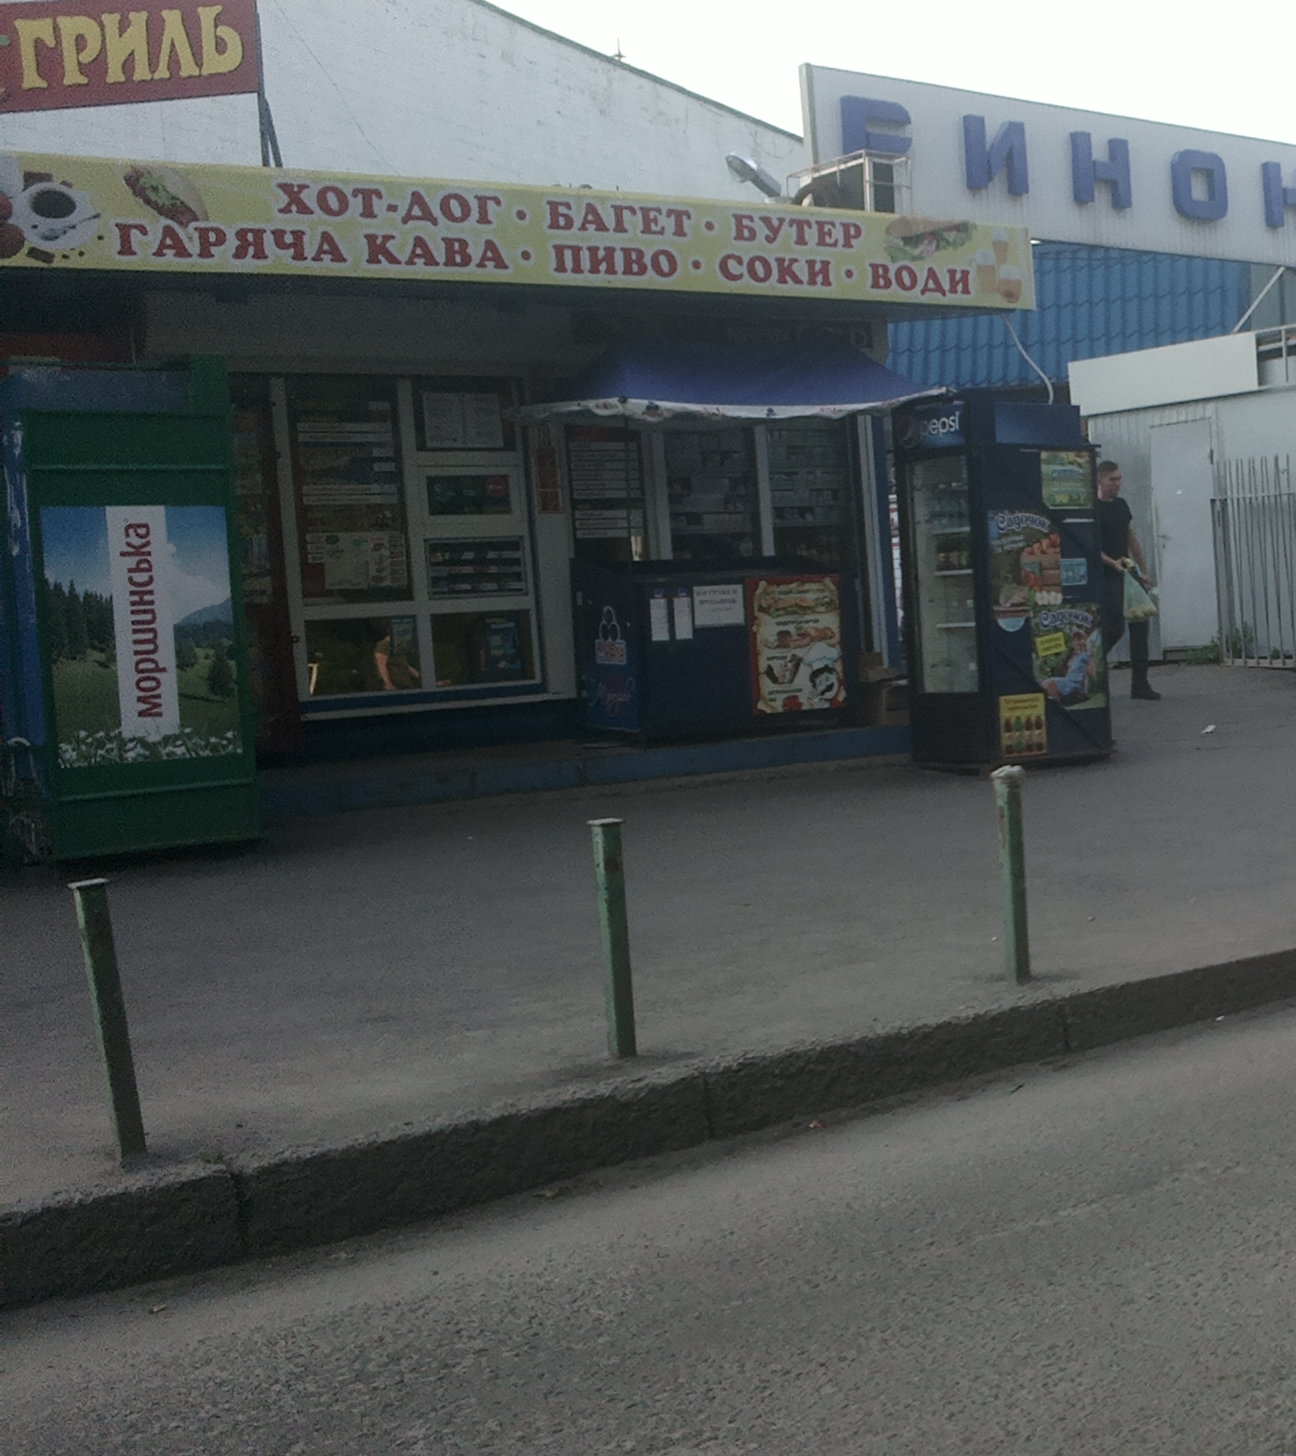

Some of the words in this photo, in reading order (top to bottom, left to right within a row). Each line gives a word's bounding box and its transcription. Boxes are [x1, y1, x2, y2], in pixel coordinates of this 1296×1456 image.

[14, 5, 244, 90] ГРИЛЬ
[275, 181, 503, 226] ХОТ-ДОГ
[546, 200, 692, 238] БАГЕТ
[732, 212, 863, 250] БУТЕР
[114, 222, 348, 264] ГАРЯЧА
[363, 233, 511, 271] КАВА
[552, 244, 679, 279] ПИВО
[718, 253, 833, 288] СОКИ
[869, 262, 973, 296] ВОДИ
